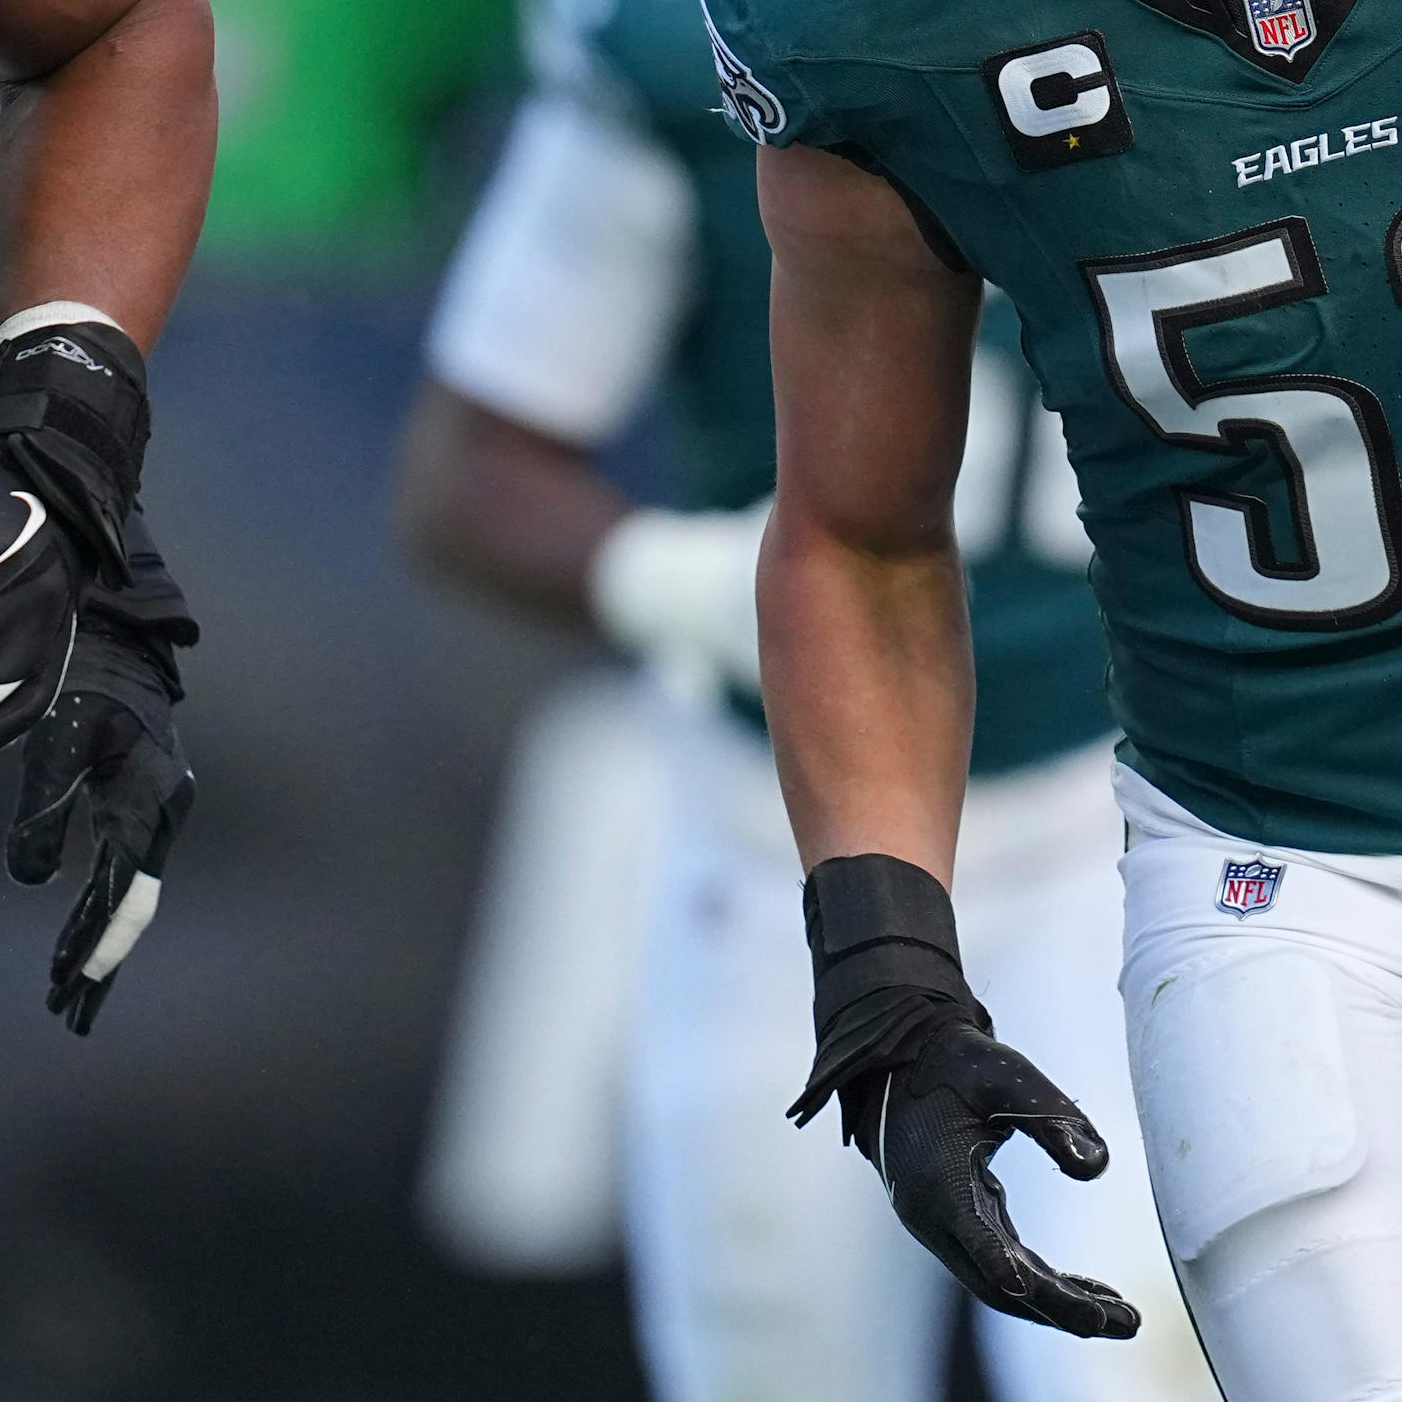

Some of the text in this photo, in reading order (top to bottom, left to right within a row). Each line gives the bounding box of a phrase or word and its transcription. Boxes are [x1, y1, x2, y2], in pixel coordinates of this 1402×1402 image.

[1259, 12, 1306, 46] NFL
[998, 43, 1111, 138] C
[1230, 115, 1399, 189] EAGLES
[1224, 879, 1269, 908] NFL
